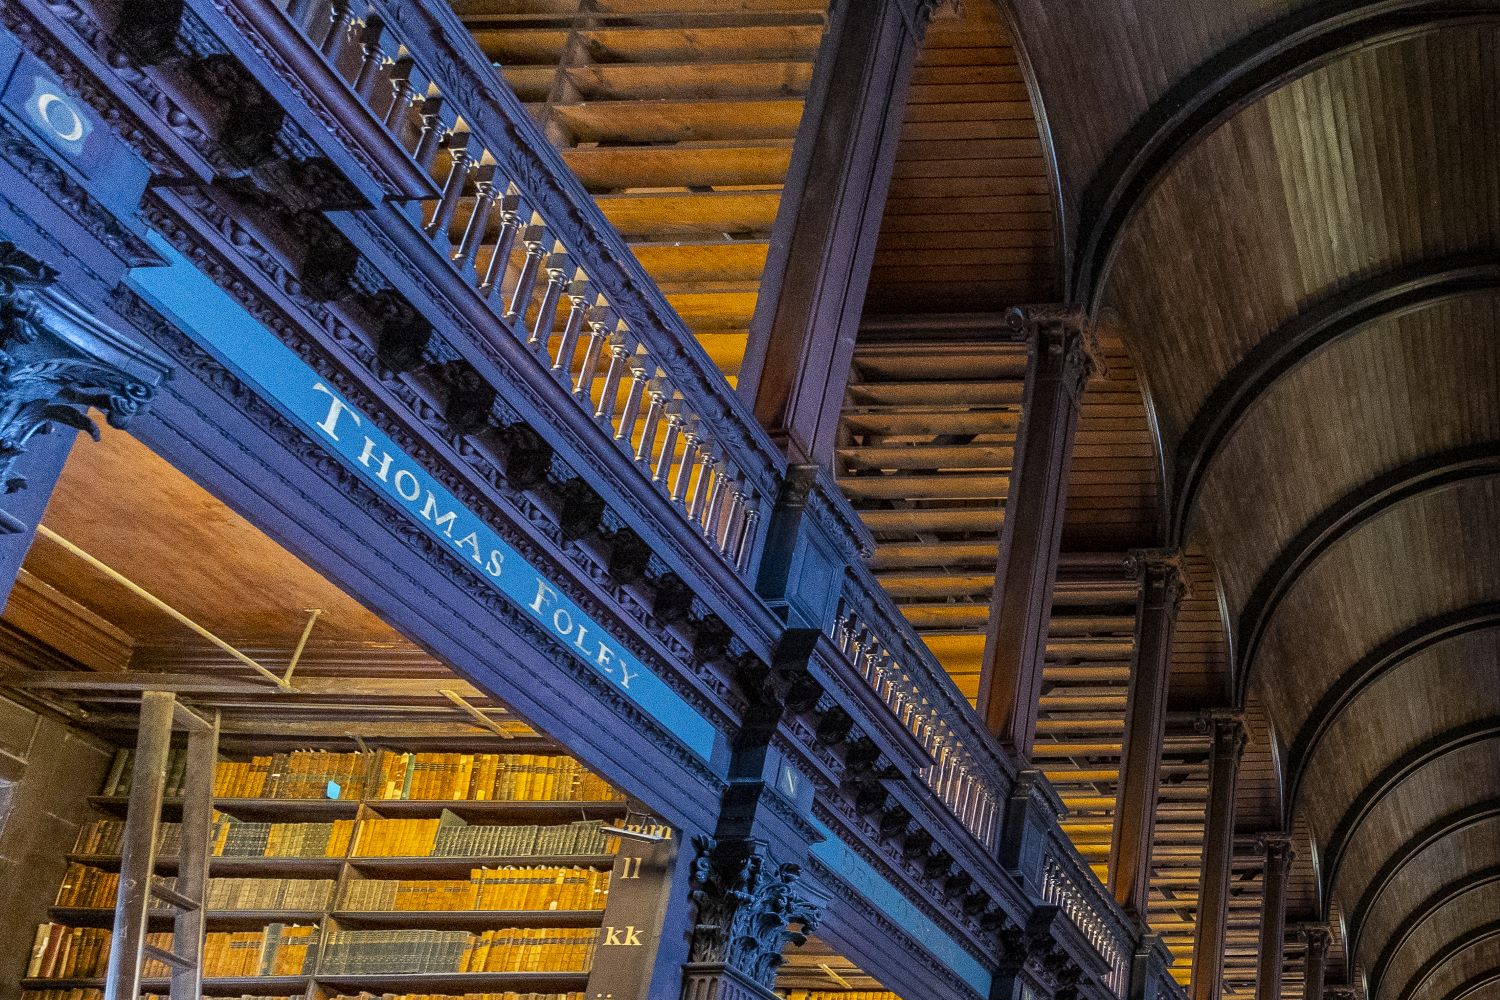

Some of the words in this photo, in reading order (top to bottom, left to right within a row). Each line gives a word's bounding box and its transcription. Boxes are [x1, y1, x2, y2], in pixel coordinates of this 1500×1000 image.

[37, 93, 83, 141] O
[312, 383, 503, 578] THOMAS
[529, 577, 640, 691] FOLEY
[620, 857, 642, 880] ll
[603, 927, 643, 947] kk
